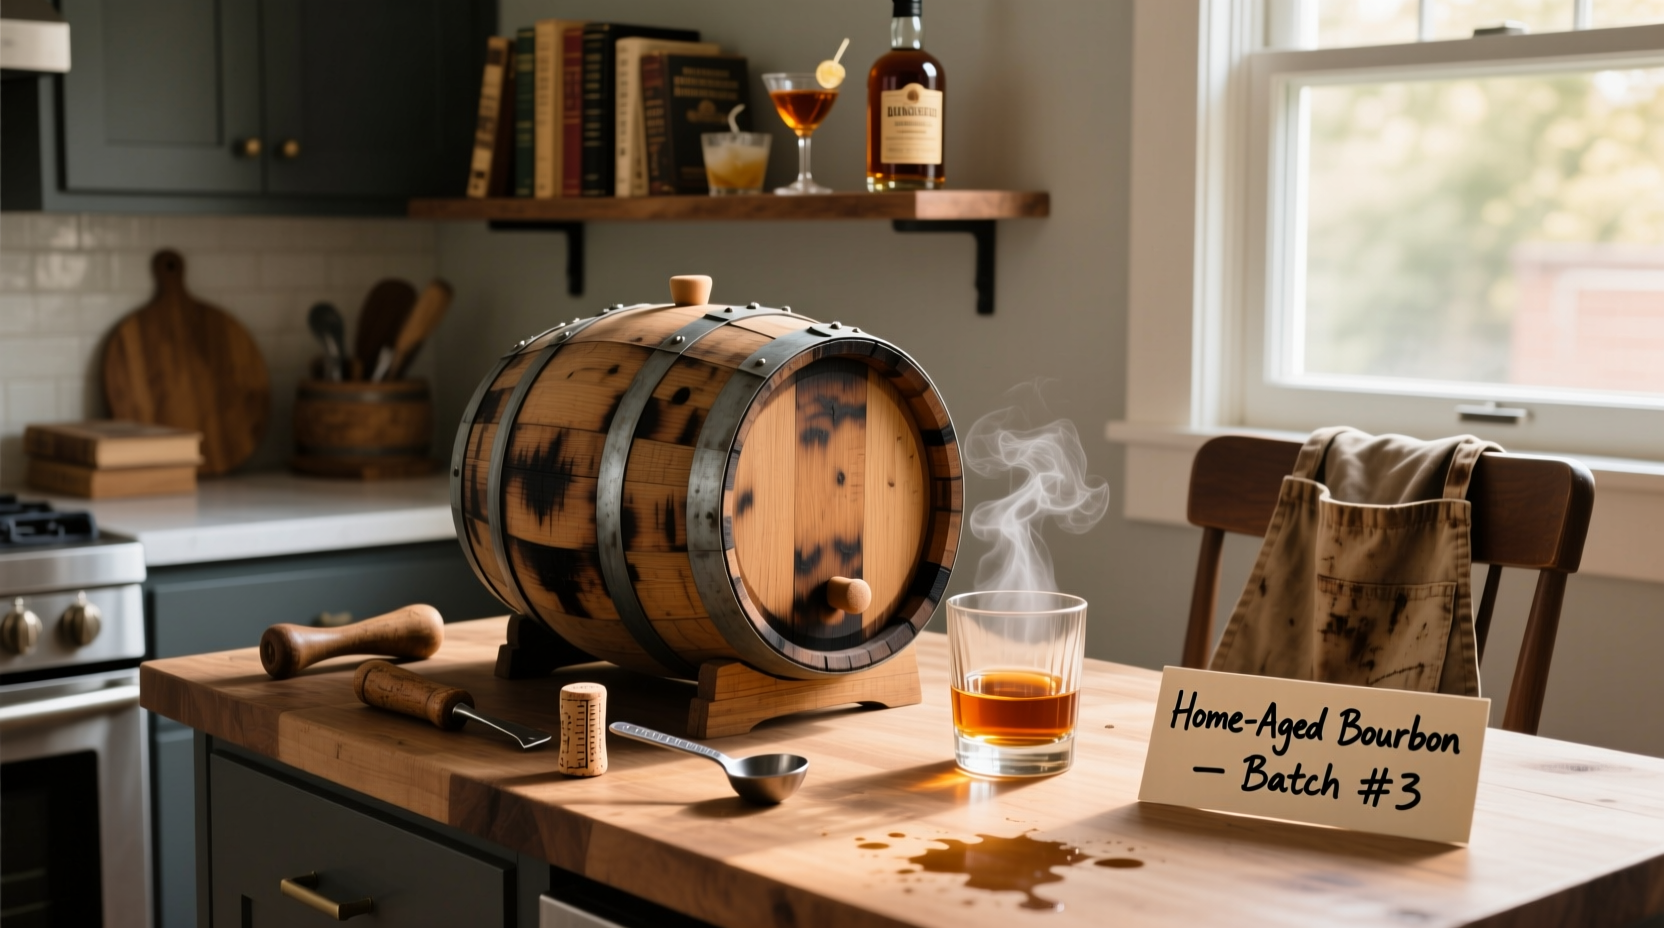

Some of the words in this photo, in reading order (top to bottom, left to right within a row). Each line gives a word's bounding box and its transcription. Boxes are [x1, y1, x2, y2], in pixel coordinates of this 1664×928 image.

[1170, 689, 1329, 757] Home-Aged
[1337, 707, 1461, 755] Bourbon
[1240, 754, 1340, 800] Batch
[1356, 767, 1422, 811] #3
